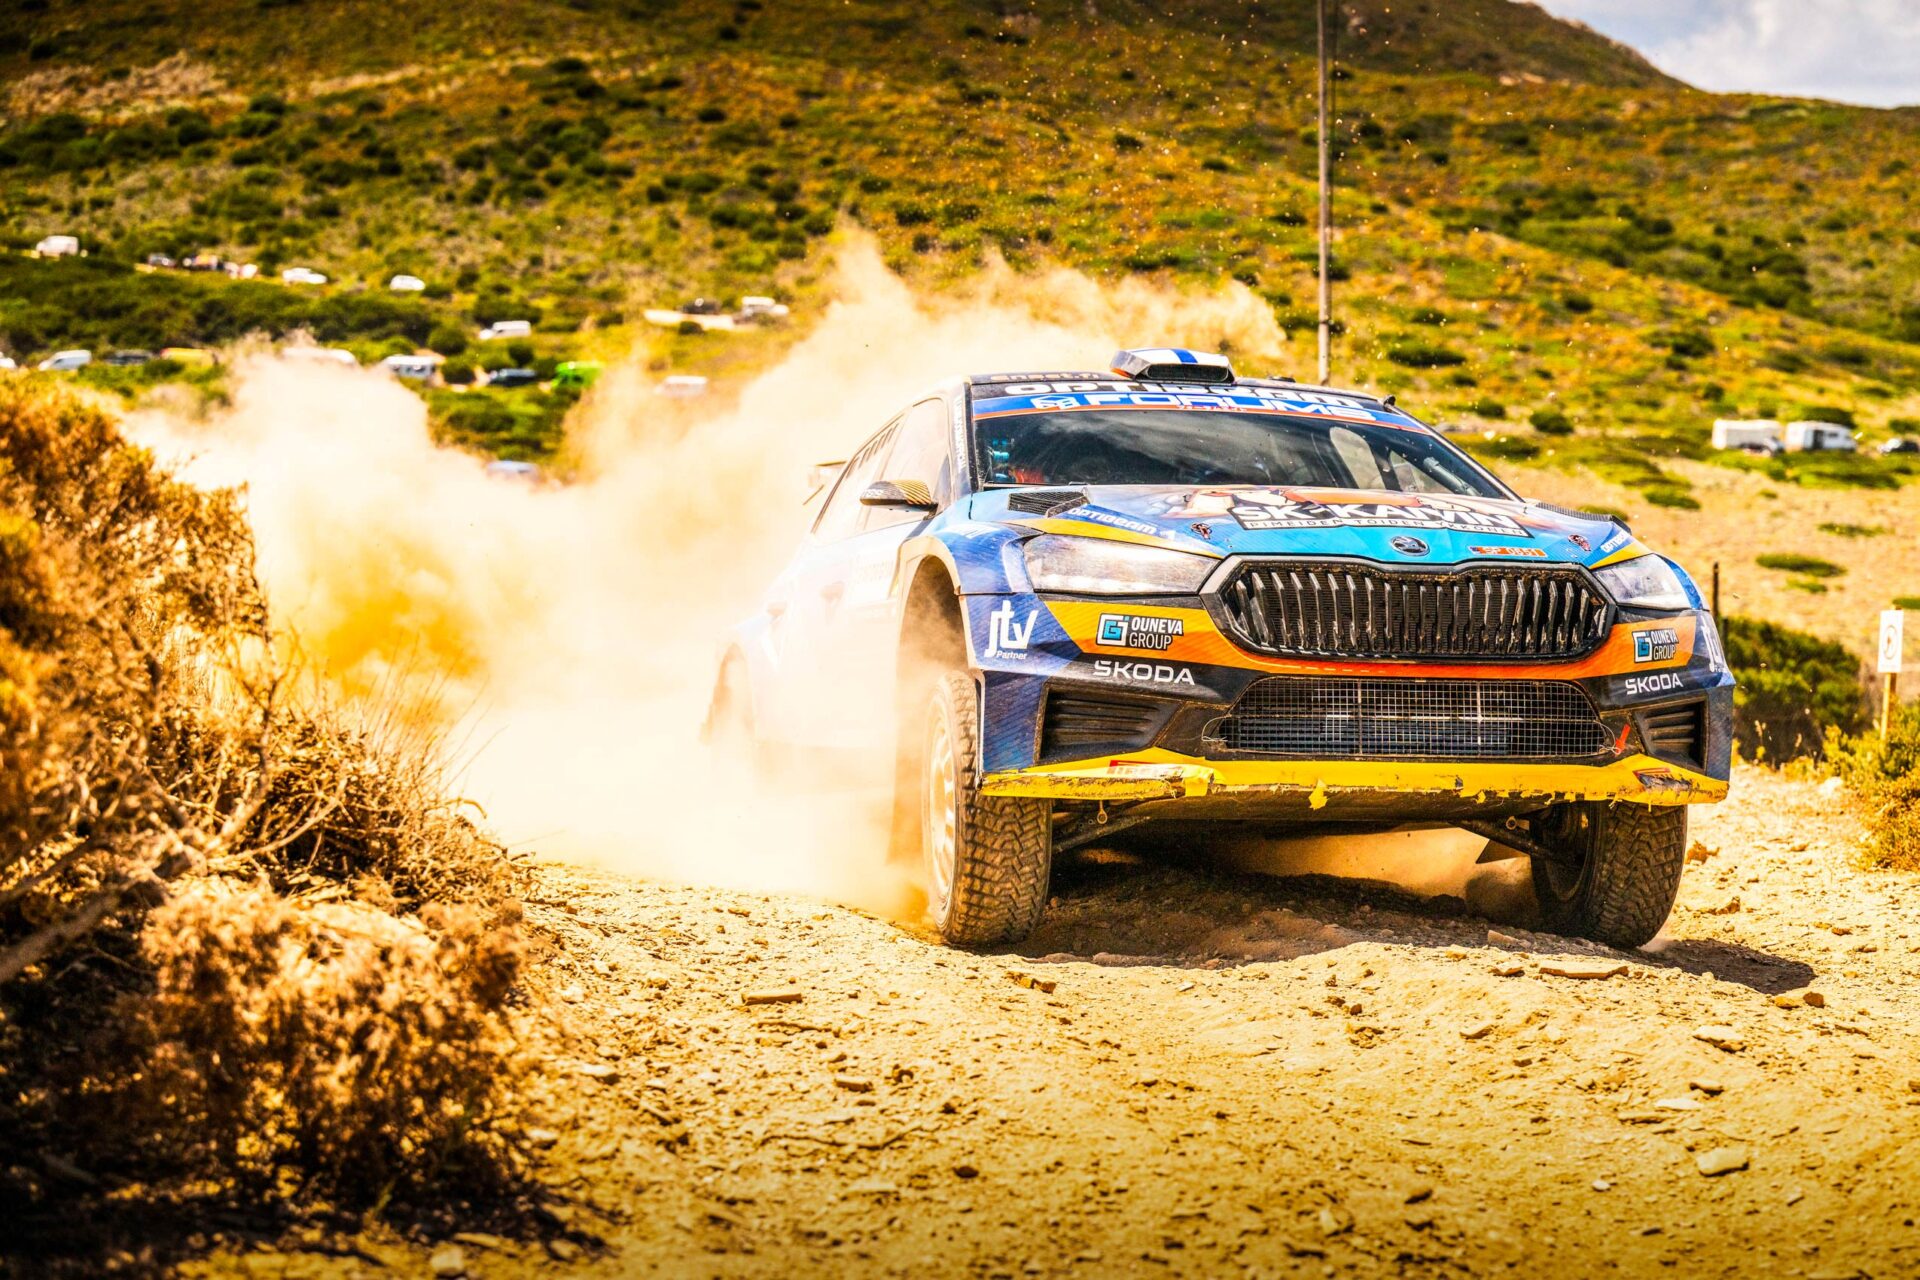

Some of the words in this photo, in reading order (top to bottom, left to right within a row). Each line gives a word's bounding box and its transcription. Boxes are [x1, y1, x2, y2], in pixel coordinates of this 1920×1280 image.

[1249, 518, 1343, 529] PIMEIDEN
[1131, 616, 1183, 635] OUNEVA
[1129, 632, 1172, 649] GROUP
[1650, 629, 1679, 644] OUNEVA
[996, 650, 1027, 660] Partner
[1653, 645, 1676, 661] GROUP
